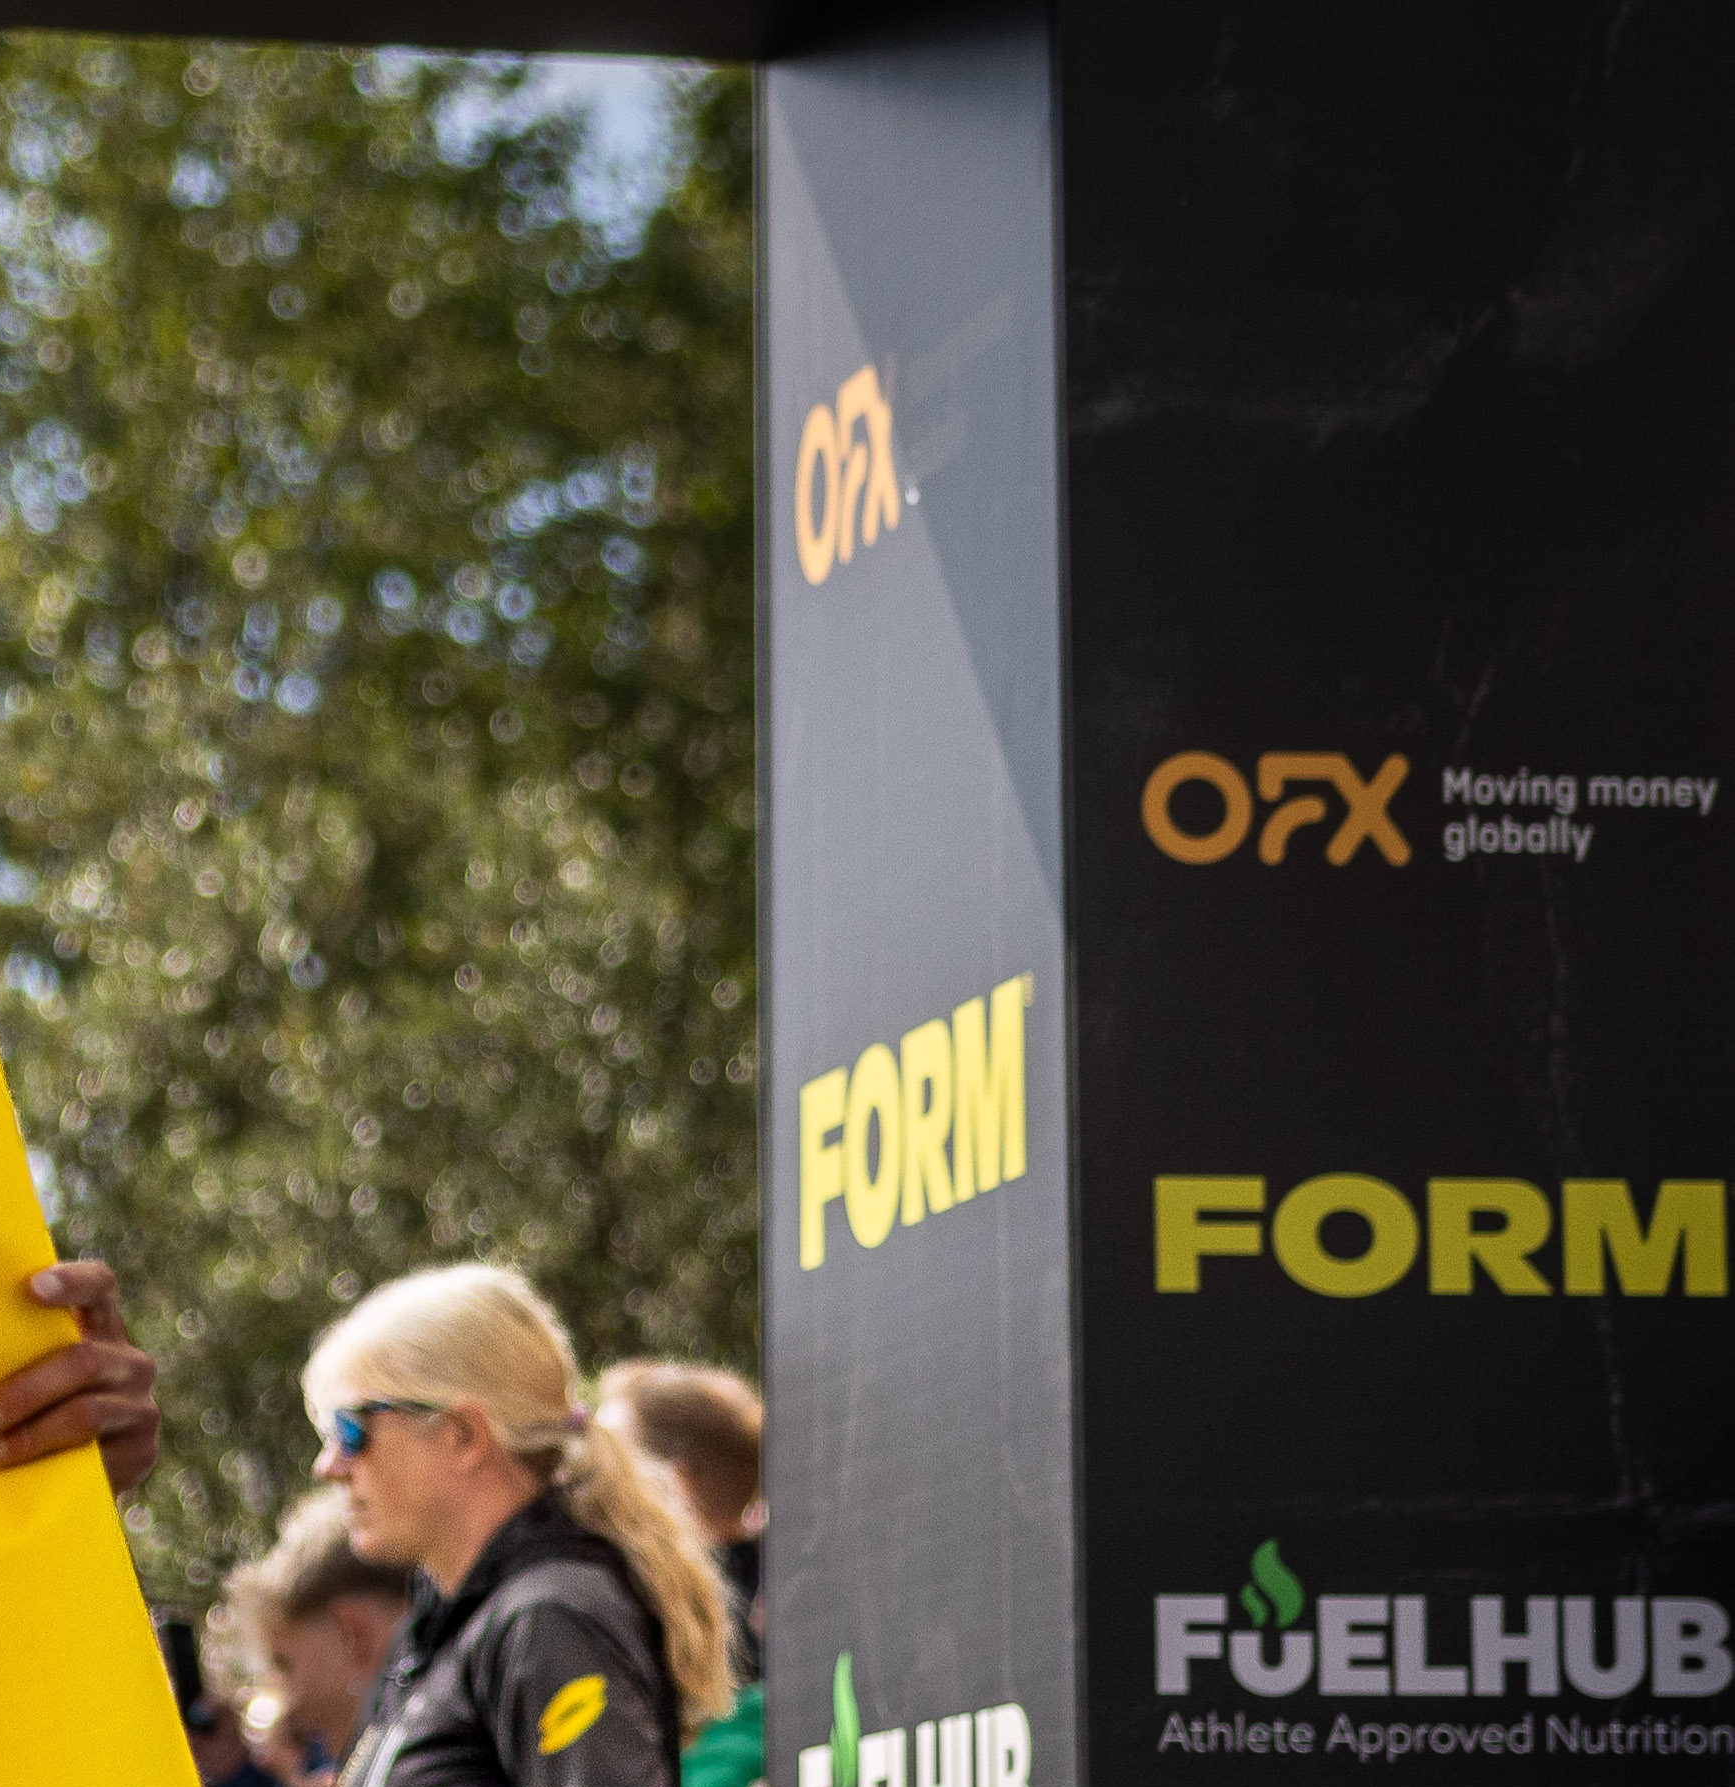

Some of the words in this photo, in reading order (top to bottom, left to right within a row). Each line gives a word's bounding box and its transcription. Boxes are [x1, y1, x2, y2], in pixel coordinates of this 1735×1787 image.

[795, 352, 900, 584] OFX
[1142, 752, 1411, 866] OFX
[1443, 766, 1578, 816] Moving
[1589, 775, 1718, 817] money
[1443, 816, 1593, 863] globally
[800, 975, 1027, 1270] FORM
[1154, 1172, 1727, 1297] FORM
[1154, 1594, 1733, 1699] FUELHUB
[1158, 1713, 1315, 1754] Athlete
[1326, 1713, 1533, 1762] Approved
[1546, 1715, 1735, 1755] Nutrition
